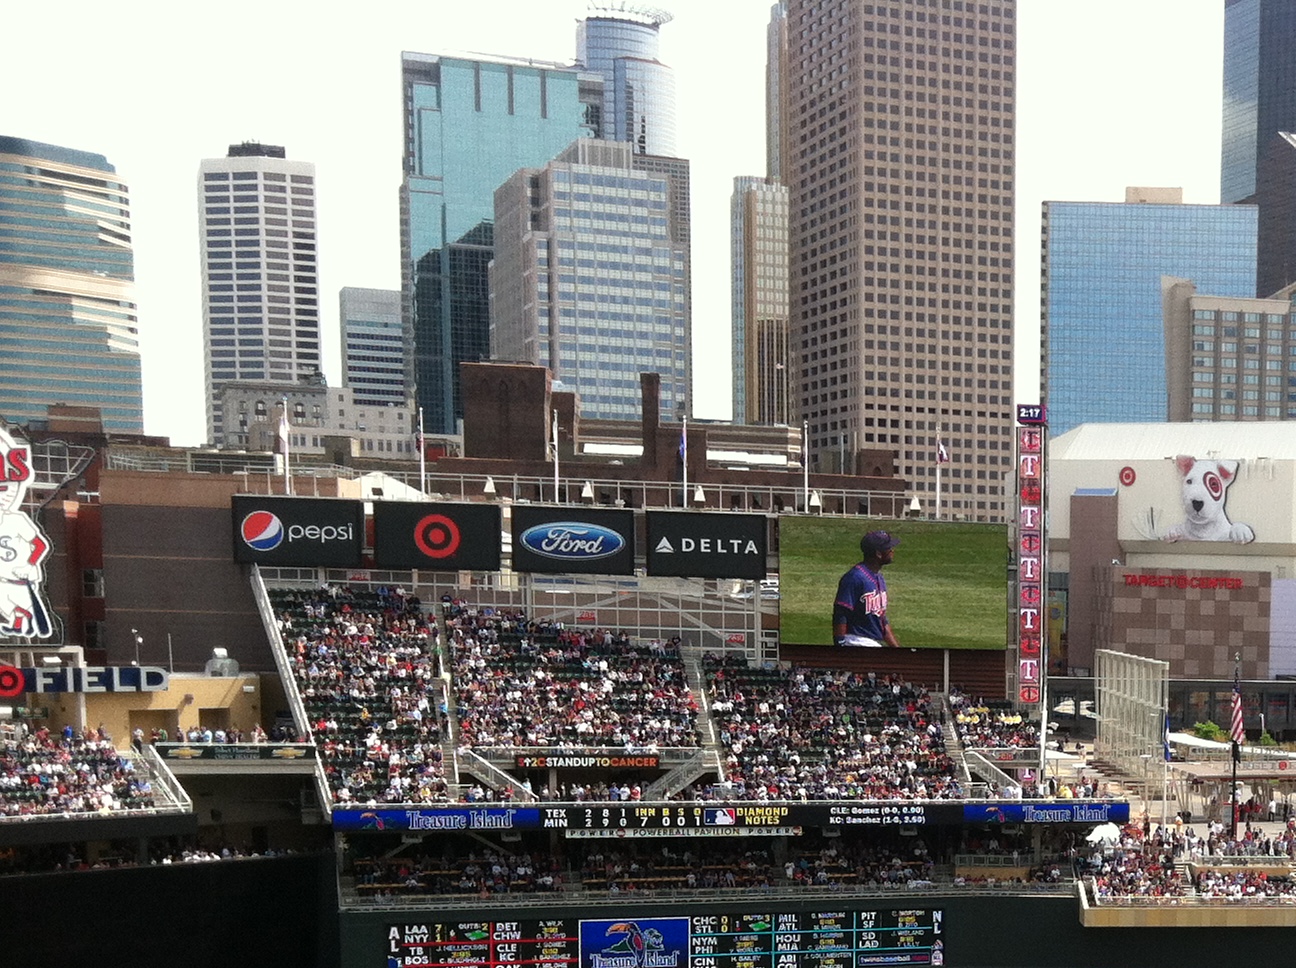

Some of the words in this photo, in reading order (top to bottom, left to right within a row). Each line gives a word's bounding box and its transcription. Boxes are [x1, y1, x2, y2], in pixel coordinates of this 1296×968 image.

[1020, 408, 1040, 418] 2:17
[288, 523, 353, 543] pepsi
[541, 527, 604, 554] Ford
[681, 537, 759, 555] DELTA
[1123, 574, 1175, 587] TARGET
[1190, 576, 1244, 589] CENTER
[36, 667, 169, 692] FIELD
[545, 809, 566, 818] TEX
[736, 807, 789, 816] DIAMOND
[1022, 804, 1070, 823] Treasure
[1072, 804, 1111, 822] Island
[406, 809, 467, 830] Treasure
[469, 809, 516, 830] Island
[543, 818, 568, 828] MIN
[745, 816, 781, 825] NOTES
[693, 916, 717, 926] CHC
[778, 914, 798, 923] MIL
[496, 922, 519, 932] DET
[695, 925, 714, 934] STL
[778, 922, 798, 931] ATL
[863, 920, 875, 929] SF
[405, 925, 428, 935] LAA
[404, 934, 429, 944] NYY
[493, 931, 521, 941] CHW
[776, 934, 800, 944] HOU
[862, 931, 876, 940] SD
[692, 936, 717, 946] NYM
[859, 940, 879, 949] LAD
[409, 946, 424, 956] TB
[497, 943, 517, 953] CLE
[695, 946, 714, 954] PHI
[777, 943, 799, 951] MIA
[405, 956, 429, 965] BOS
[500, 952, 516, 962] KC
[589, 953, 637, 968] Treasure
[643, 951, 680, 968] Island
[694, 957, 715, 966] CIN
[779, 954, 797, 963] ARI
